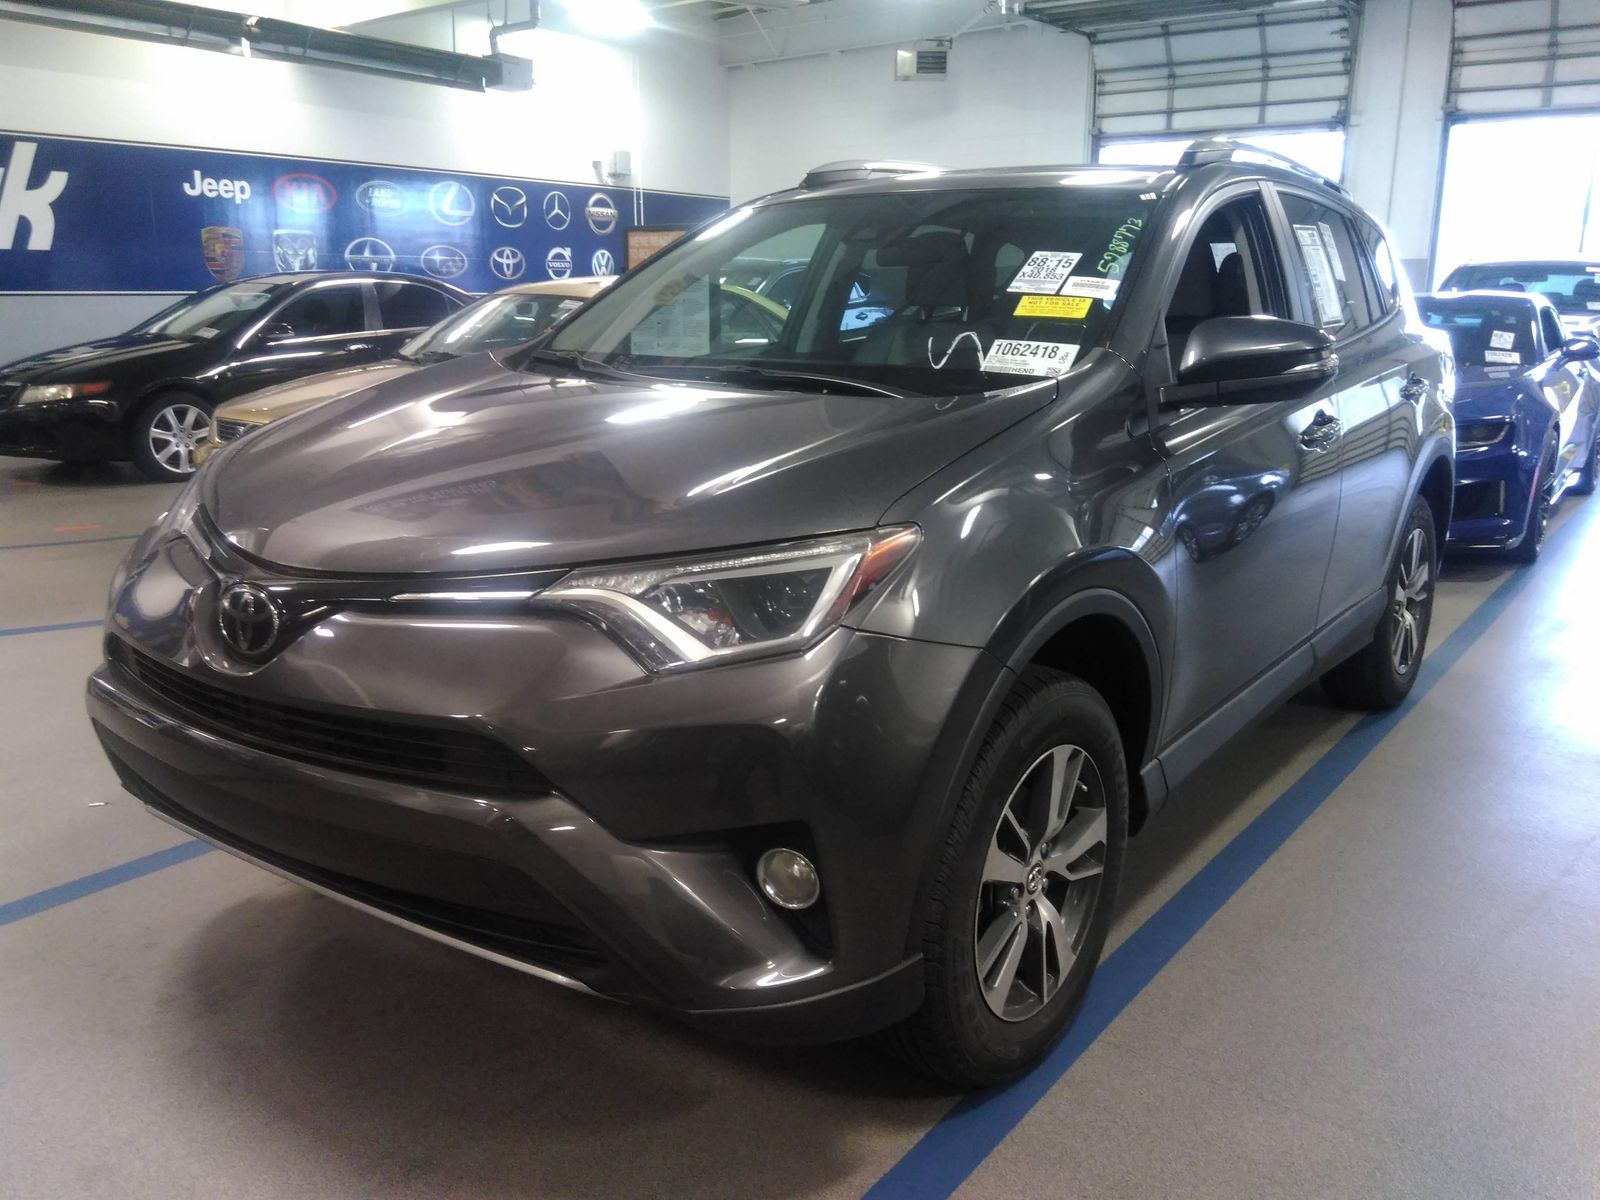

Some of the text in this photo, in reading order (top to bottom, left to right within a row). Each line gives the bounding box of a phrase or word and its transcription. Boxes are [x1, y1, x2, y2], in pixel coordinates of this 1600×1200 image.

[182, 170, 252, 204] Jeep
[368, 187, 393, 198] LAND
[0, 141, 69, 251] k
[588, 210, 615, 218] NISSAN
[995, 342, 1060, 359] 1062418
